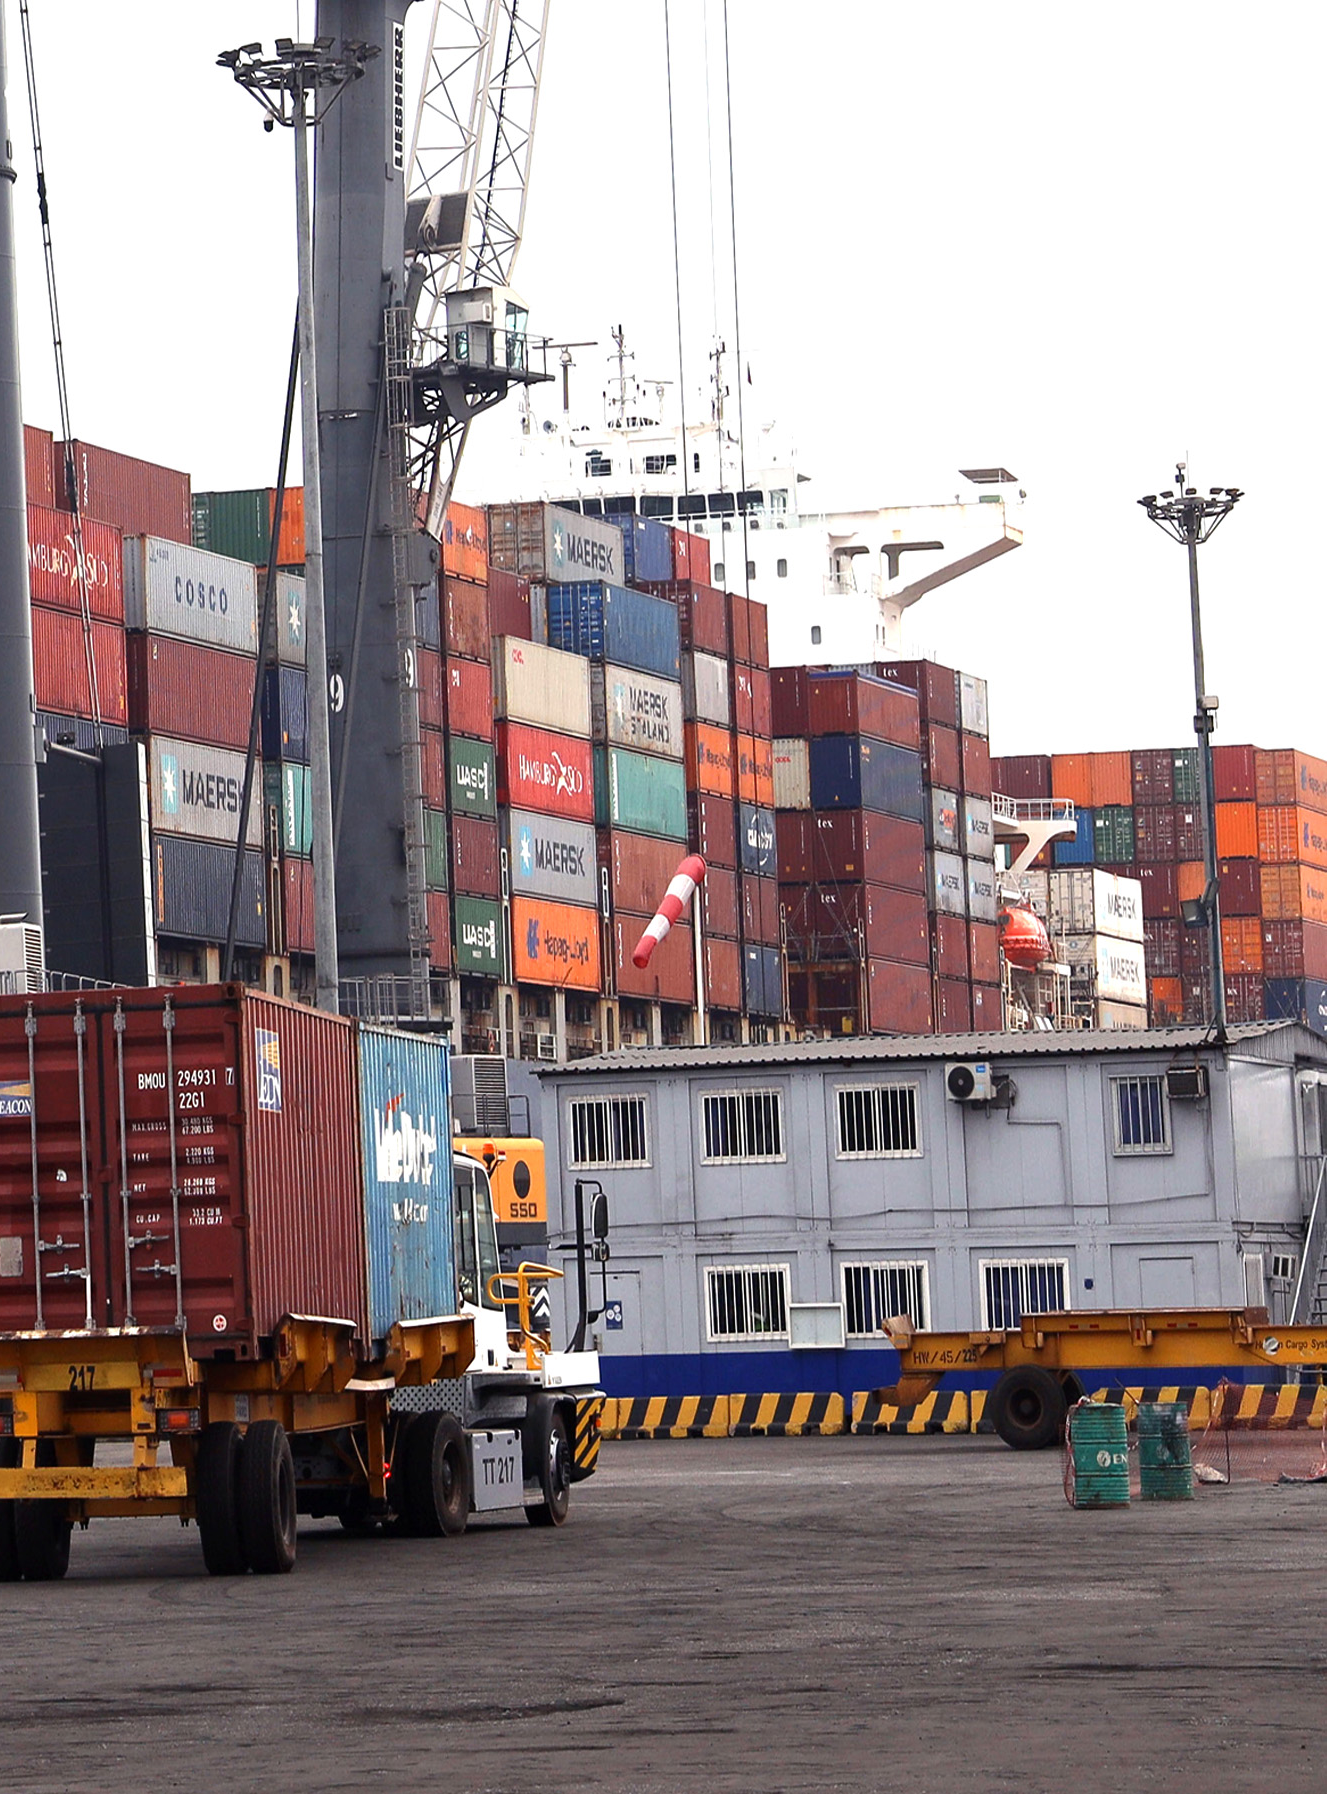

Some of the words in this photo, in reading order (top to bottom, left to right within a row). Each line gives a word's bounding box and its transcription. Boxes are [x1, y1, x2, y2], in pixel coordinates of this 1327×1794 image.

[567, 533, 615, 576] MAERSK
[175, 575, 228, 615] COSCO
[329, 673, 344, 712] 9
[457, 764, 485, 789] UASC
[817, 818, 834, 829] tex
[535, 838, 585, 877] MAERSK
[821, 893, 836, 904] tex
[462, 923, 492, 949] UASC
[138, 1072, 166, 1090] BMOU
[177, 1068, 216, 1087] 294931
[226, 1067, 234, 1086] 7
[179, 1091, 204, 1109] 22G1
[1286, 1340, 1308, 1351] Cargo
[69, 1365, 95, 1391] 217
[482, 1458, 497, 1486] TT
[498, 1456, 516, 1484] 217
